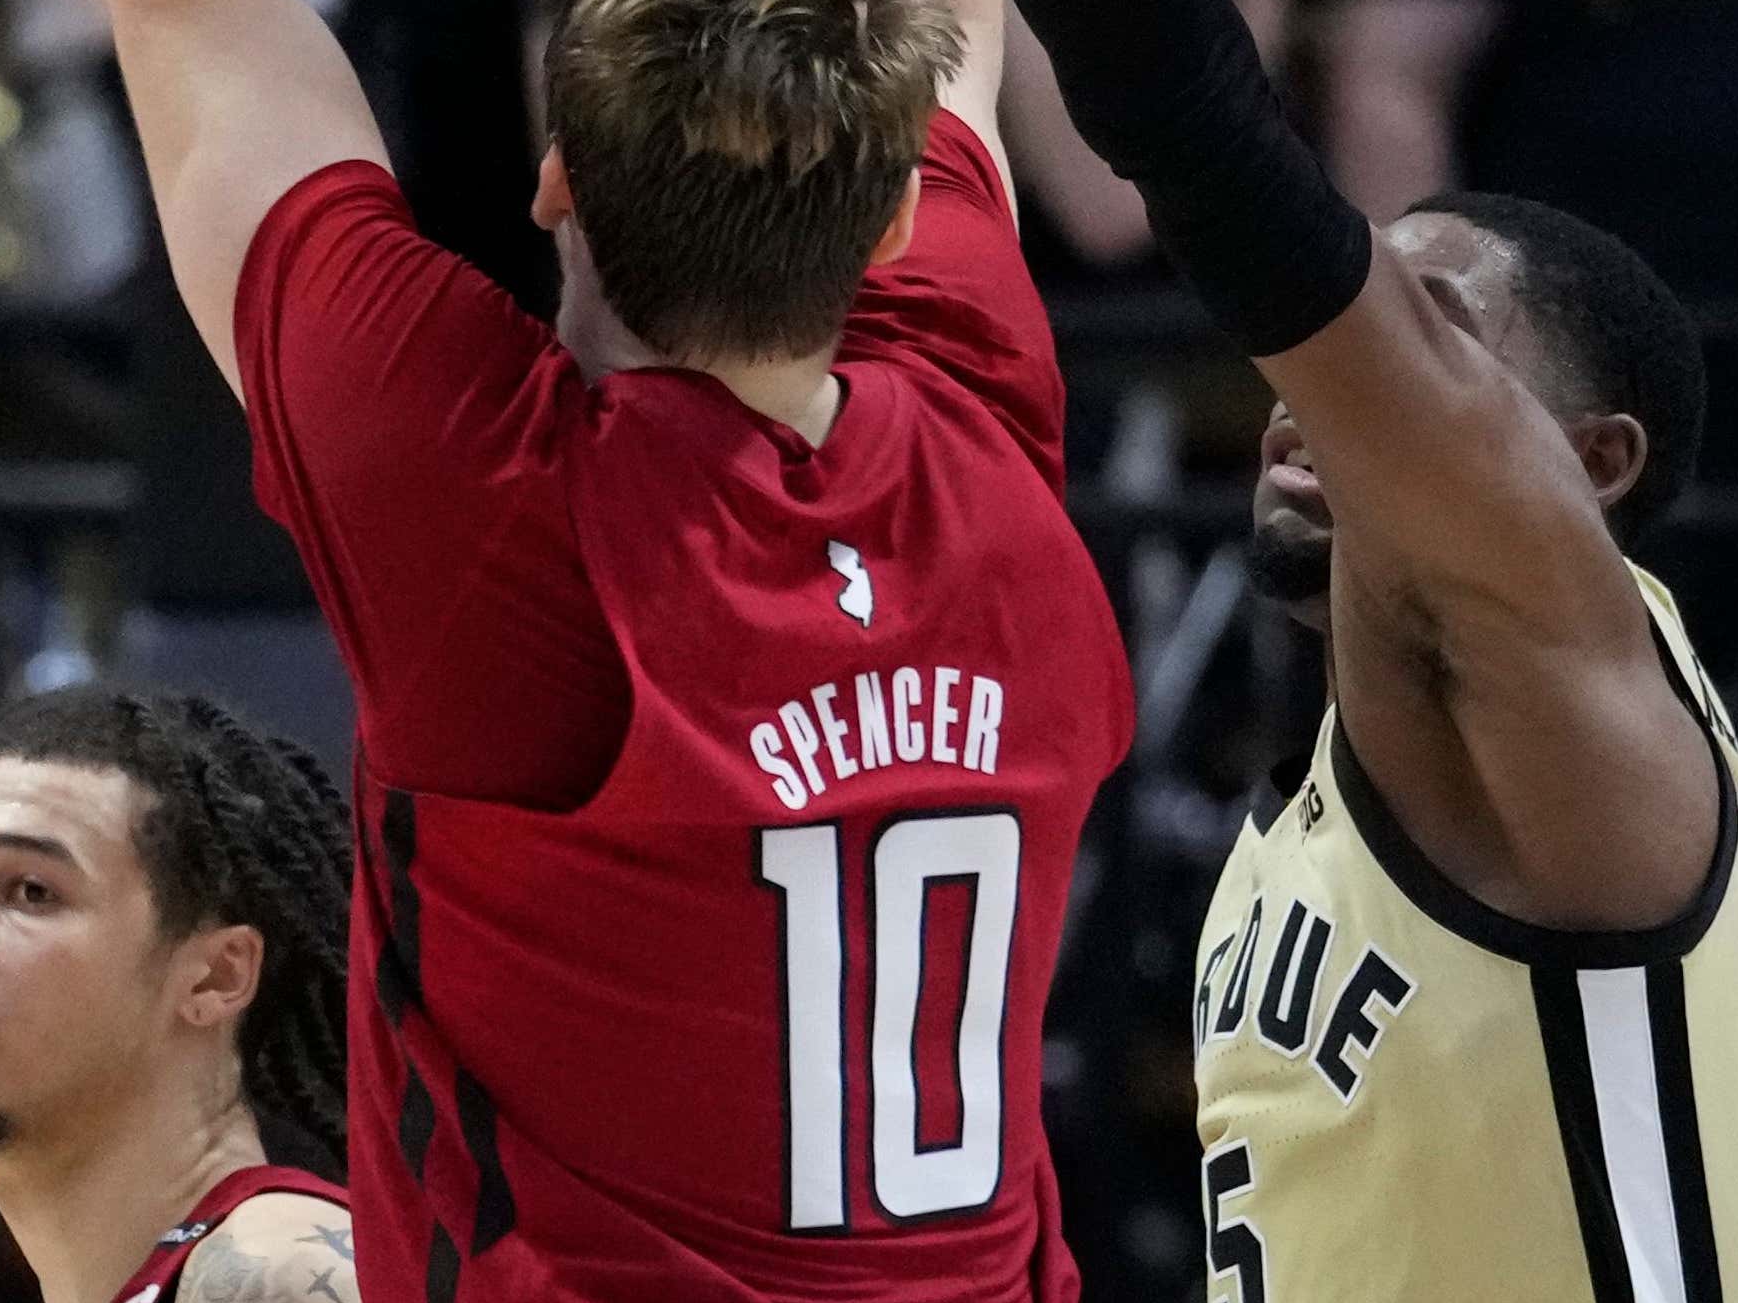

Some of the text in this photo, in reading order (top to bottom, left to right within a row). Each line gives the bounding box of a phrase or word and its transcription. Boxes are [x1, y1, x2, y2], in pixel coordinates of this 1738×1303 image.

[750, 665, 1005, 812] SPENCER
[753, 803, 1021, 1235] 10
[1195, 894, 1417, 1104] RDUE
